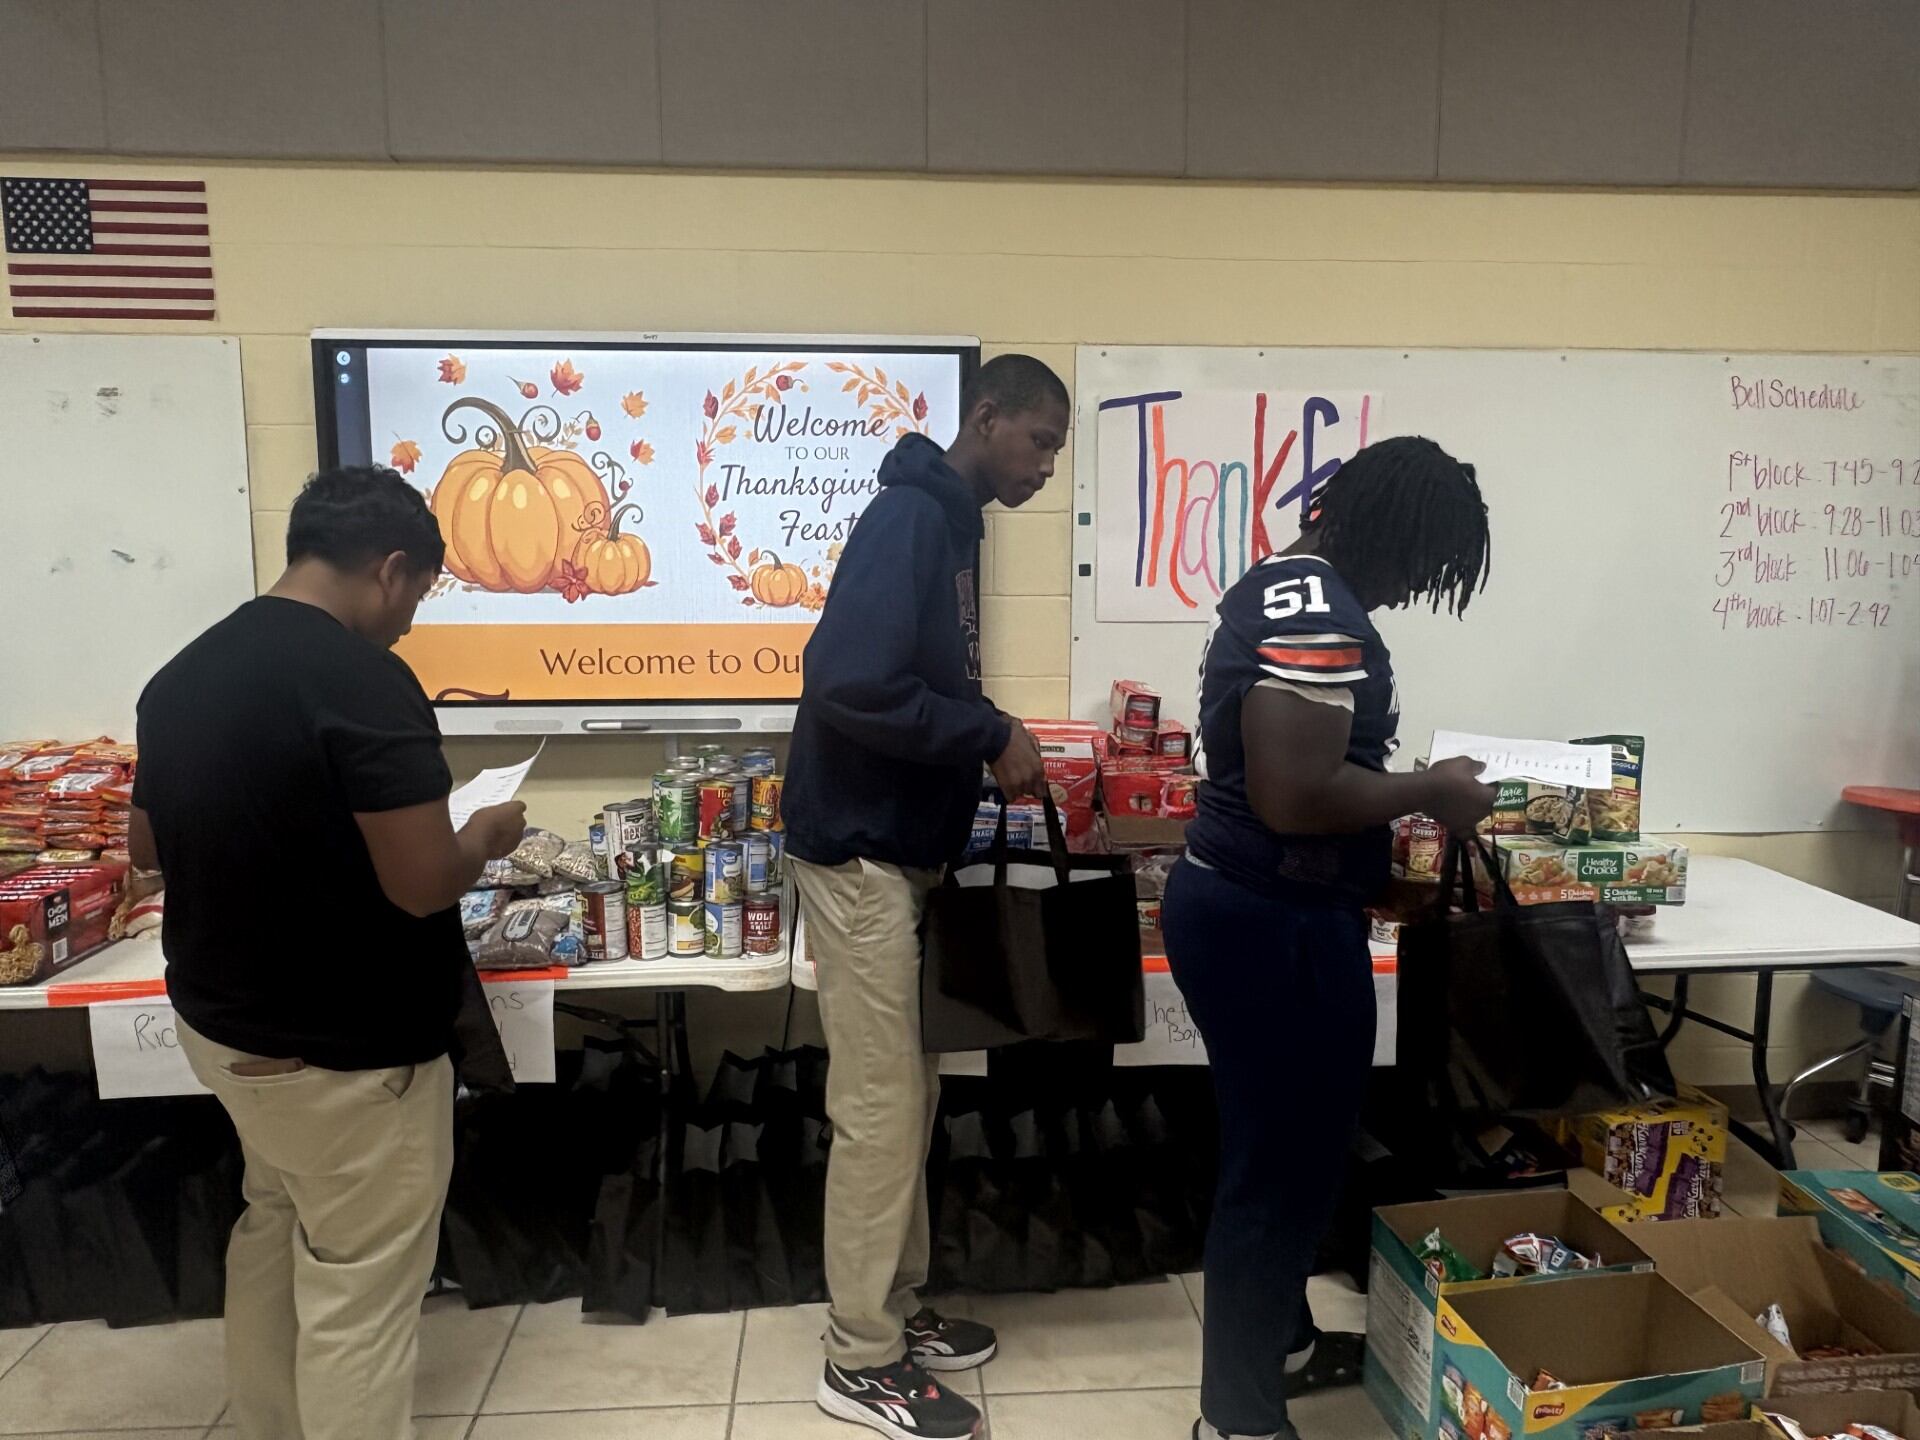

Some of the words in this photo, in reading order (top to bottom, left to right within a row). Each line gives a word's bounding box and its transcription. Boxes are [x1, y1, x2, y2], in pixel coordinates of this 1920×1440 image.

[754, 403, 890, 444] Welcome
[784, 446, 809, 460] TO
[814, 446, 850, 460] OUR
[720, 464, 886, 514] Thanksgivi
[1099, 390, 1371, 608] Thankf
[779, 509, 862, 547] Feast
[1263, 576, 1331, 620] 51
[539, 647, 696, 675] Welcome
[706, 649, 742, 675] to
[753, 647, 801, 674] Ou
[1581, 865, 1619, 875] Choice
[1586, 857, 1618, 868] Healthy
[747, 911, 775, 921] WOLF
[134, 1013, 178, 1052] Ric
